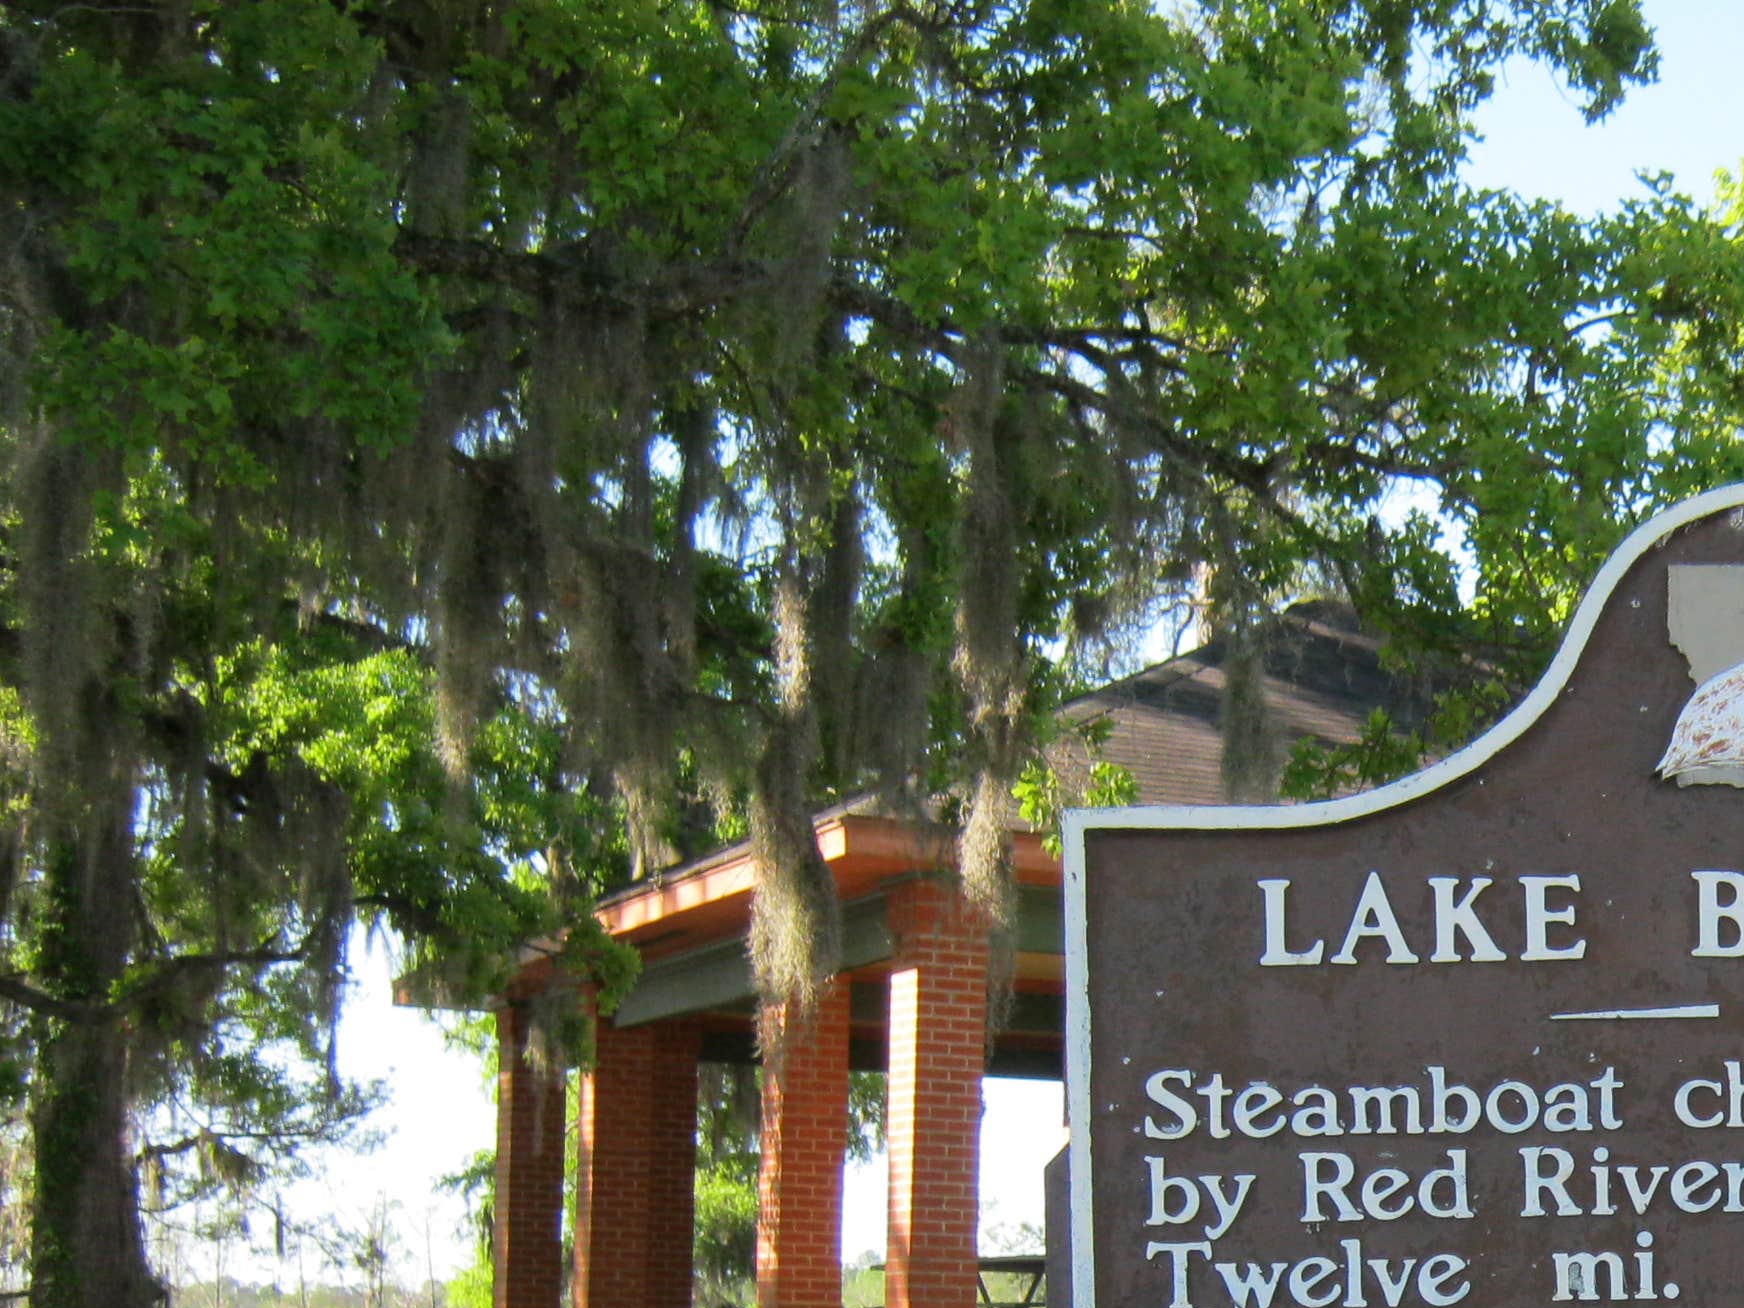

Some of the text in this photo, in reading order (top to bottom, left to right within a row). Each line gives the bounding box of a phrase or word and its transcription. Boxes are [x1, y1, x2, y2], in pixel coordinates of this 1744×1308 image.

[1256, 870, 1588, 967] LAKE
[1143, 1065, 1626, 1141] Steamboat
[1142, 1154, 1258, 1242] by
[1297, 1146, 1476, 1224] Red
[1550, 1229, 1681, 1303] mi.
